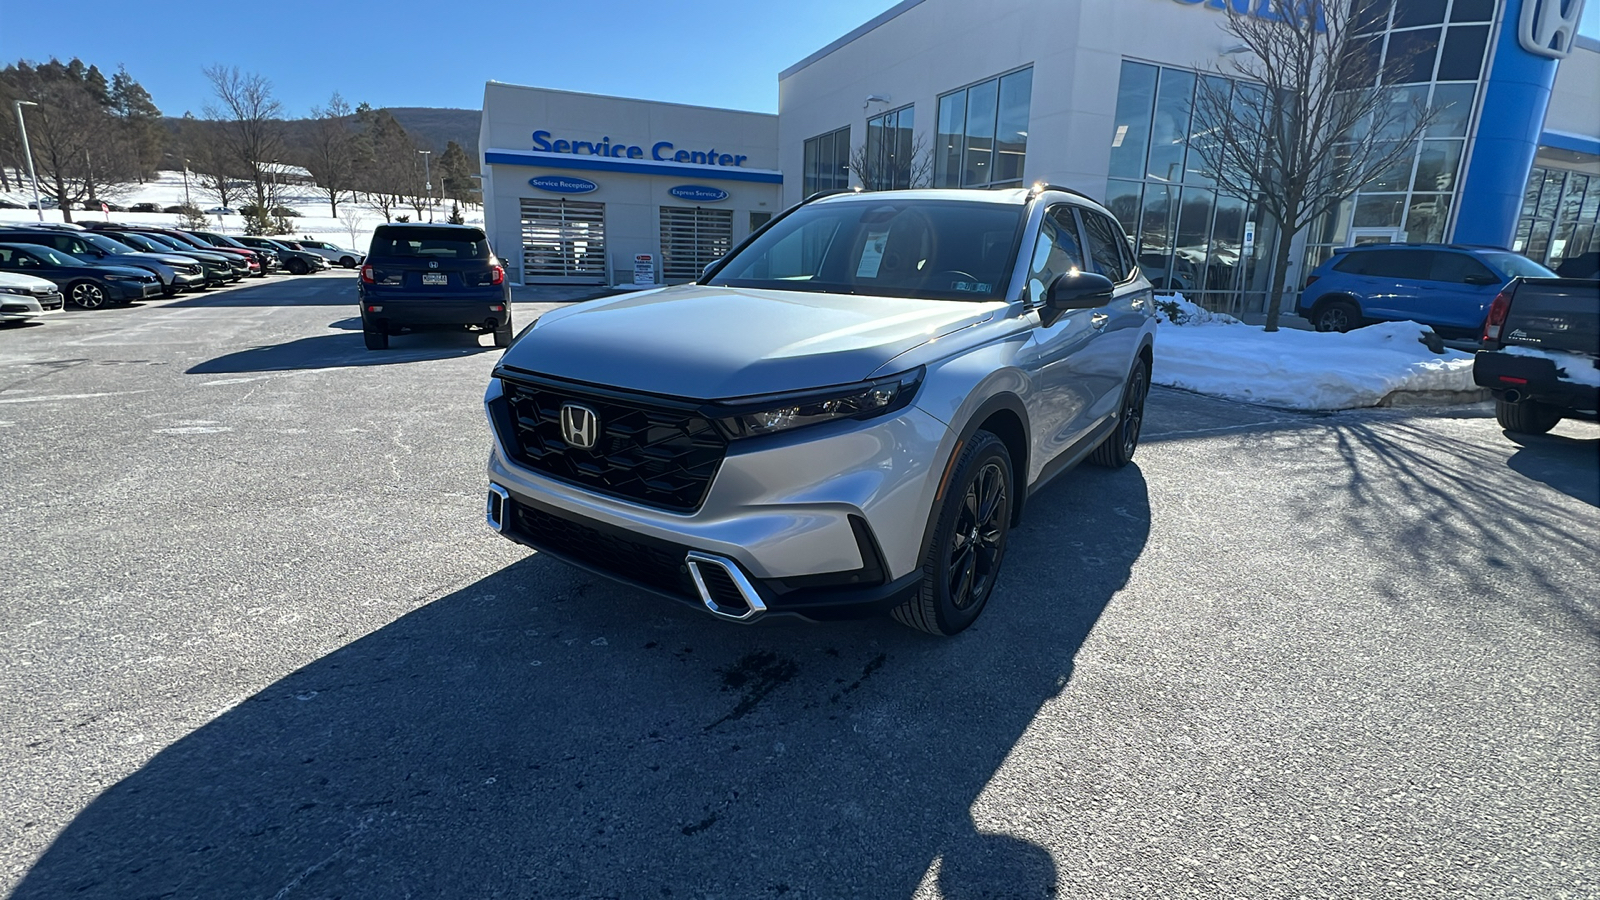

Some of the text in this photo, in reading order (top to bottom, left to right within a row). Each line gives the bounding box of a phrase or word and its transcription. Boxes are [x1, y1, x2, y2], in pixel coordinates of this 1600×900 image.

[532, 130, 747, 166] Service Center
[533, 179, 594, 189] Service Reception
[672, 188, 695, 196] Express
